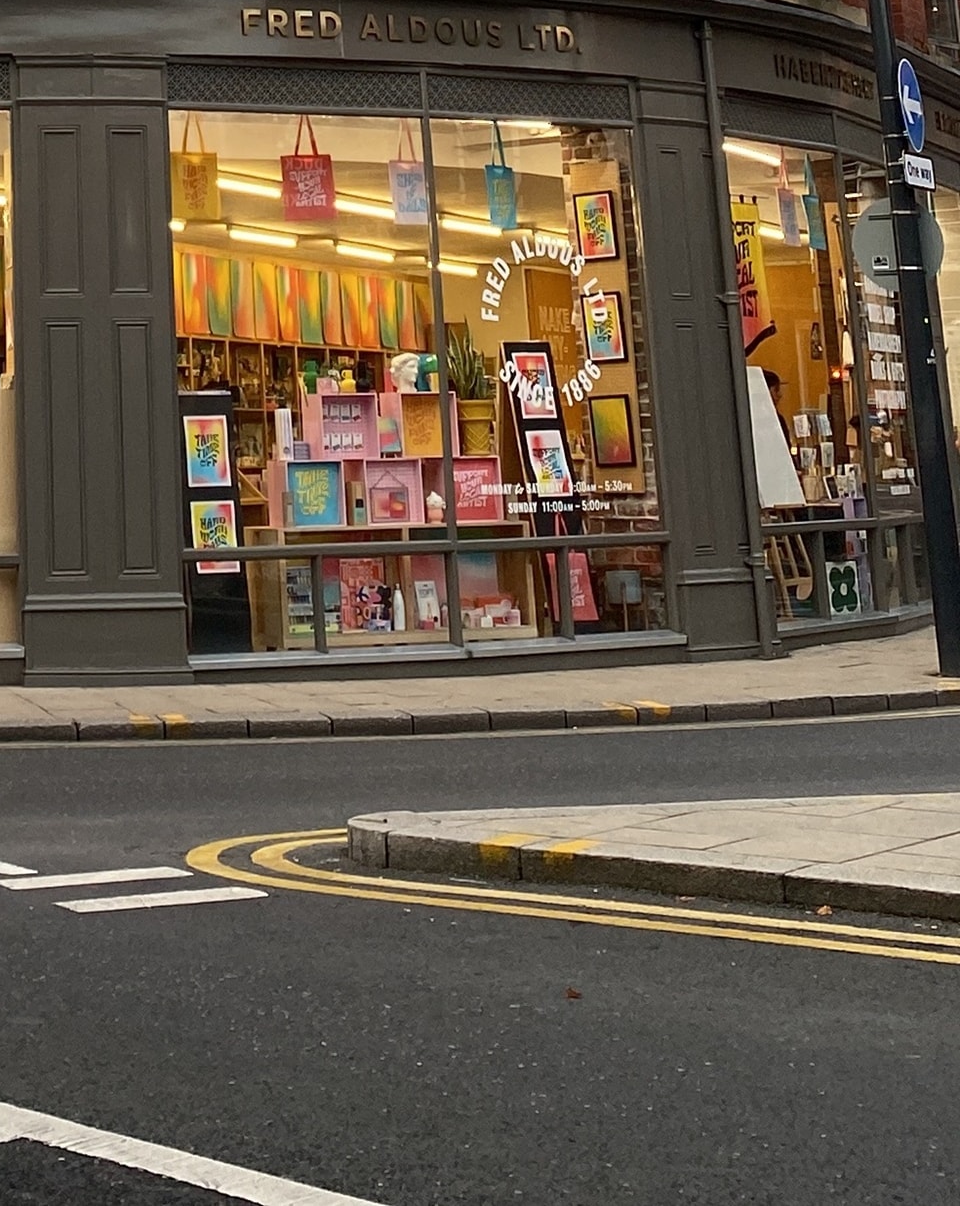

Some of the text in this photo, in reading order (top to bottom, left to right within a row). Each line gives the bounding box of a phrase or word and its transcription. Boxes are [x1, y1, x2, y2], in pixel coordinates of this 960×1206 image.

[241, 8, 583, 54] FRED ALDOUS LTD.
[480, 234, 608, 323] FRED ALDOUS LTD
[499, 361, 555, 411] SINCE
[561, 359, 602, 407] 1886
[481, 483, 512, 495] MONDAY
[605, 480, 633, 492] 5:30PM
[508, 501, 537, 514] SUNDAY
[542, 500, 574, 513] 11:00AM
[582, 499, 610, 512] 5:00PM
